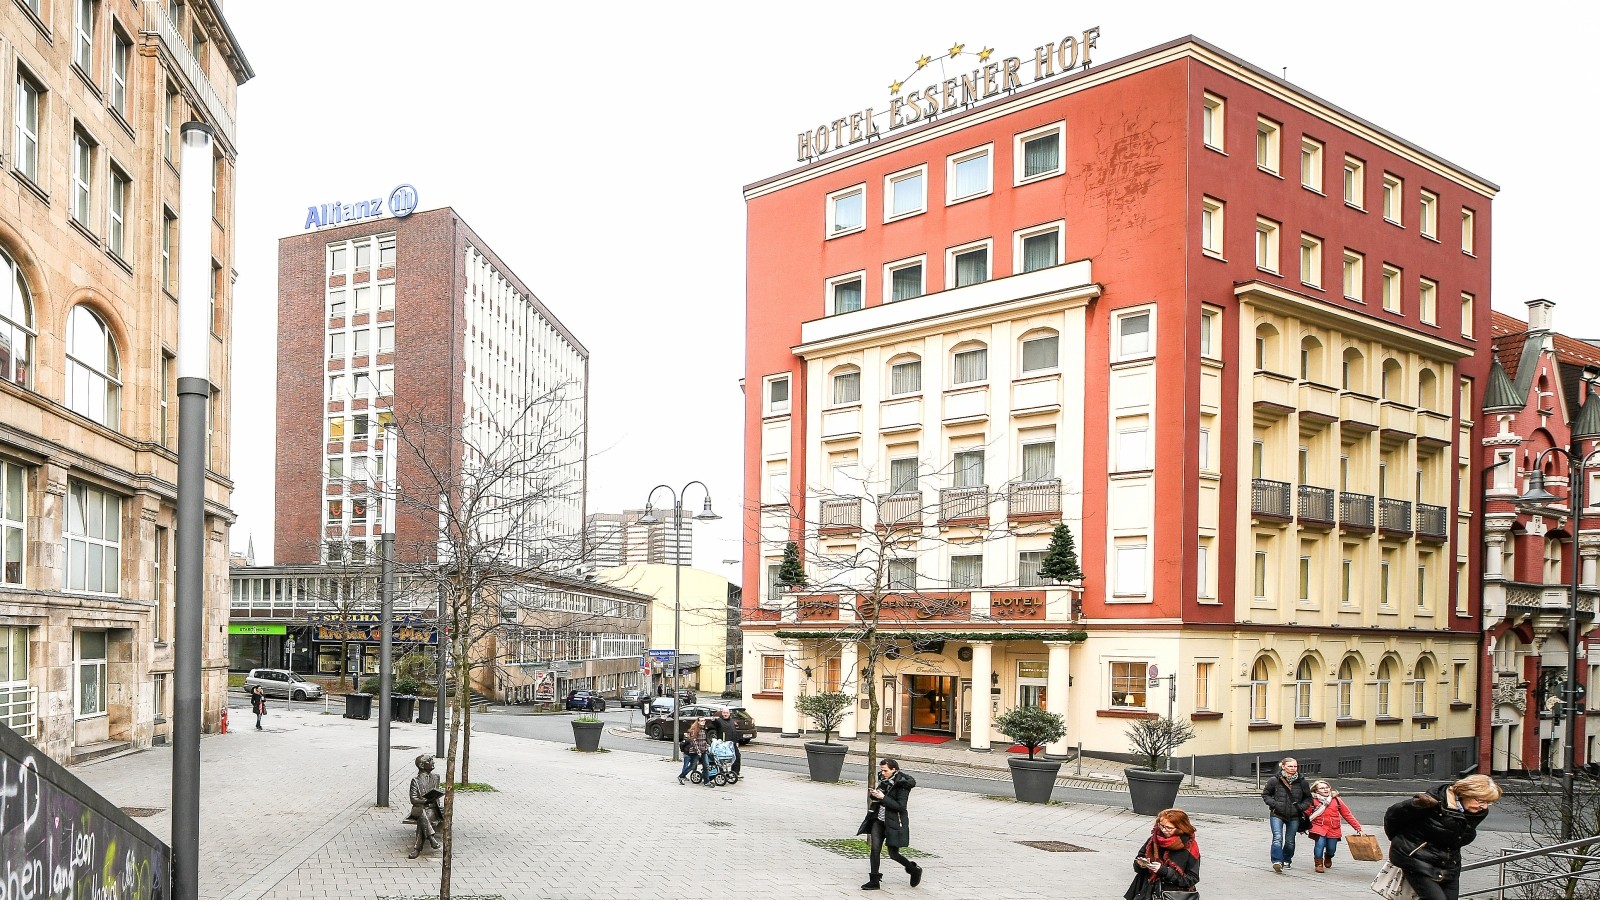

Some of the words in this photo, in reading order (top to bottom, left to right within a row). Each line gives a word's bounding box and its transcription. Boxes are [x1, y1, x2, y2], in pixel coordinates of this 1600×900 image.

[797, 107, 879, 162] HOTEL
[889, 56, 1022, 130] ESSENER
[1034, 26, 1100, 81] HOF
[305, 198, 382, 229] Allianz
[992, 597, 1043, 606] HOTEL
